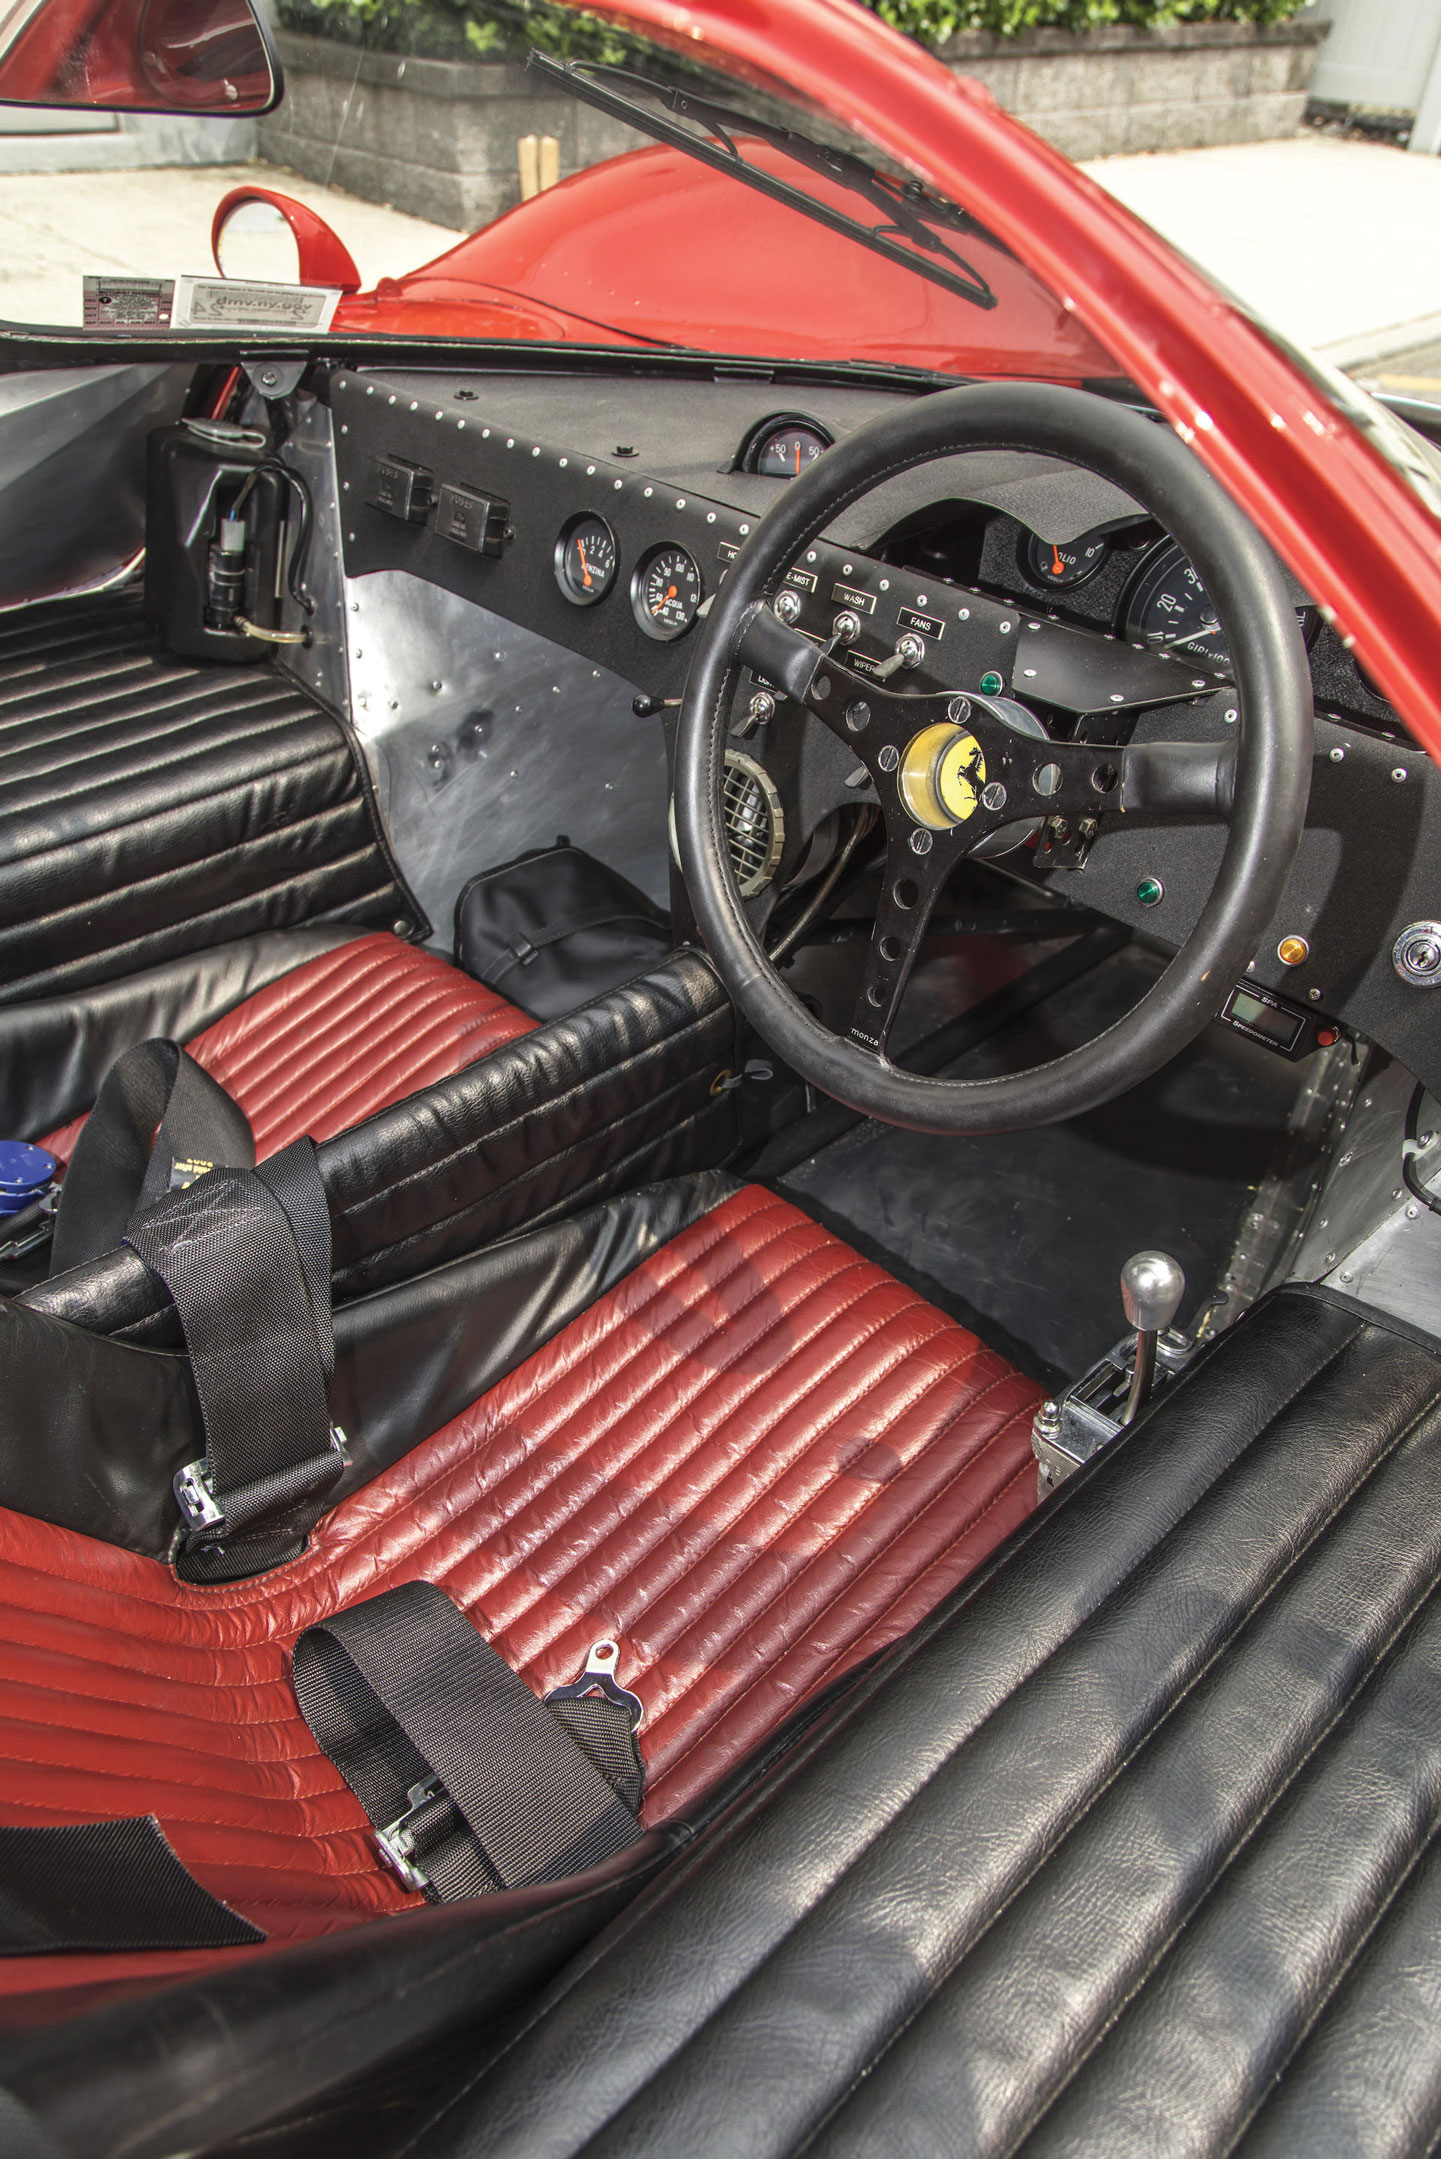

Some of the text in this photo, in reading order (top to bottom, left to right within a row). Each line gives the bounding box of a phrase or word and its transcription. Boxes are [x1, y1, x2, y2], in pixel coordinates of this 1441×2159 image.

[786, 571, 811, 586] E-MIST
[1184, 566, 1199, 585] 3
[843, 592, 866, 607] WASH
[1156, 593, 1177, 613] 20
[910, 617, 932, 631] FANS
[854, 658, 876, 674] WIPER
[1261, 996, 1279, 1009] SPA
[851, 1027, 880, 1047] monza
[1232, 1020, 1279, 1047] SPEEDOMETER
